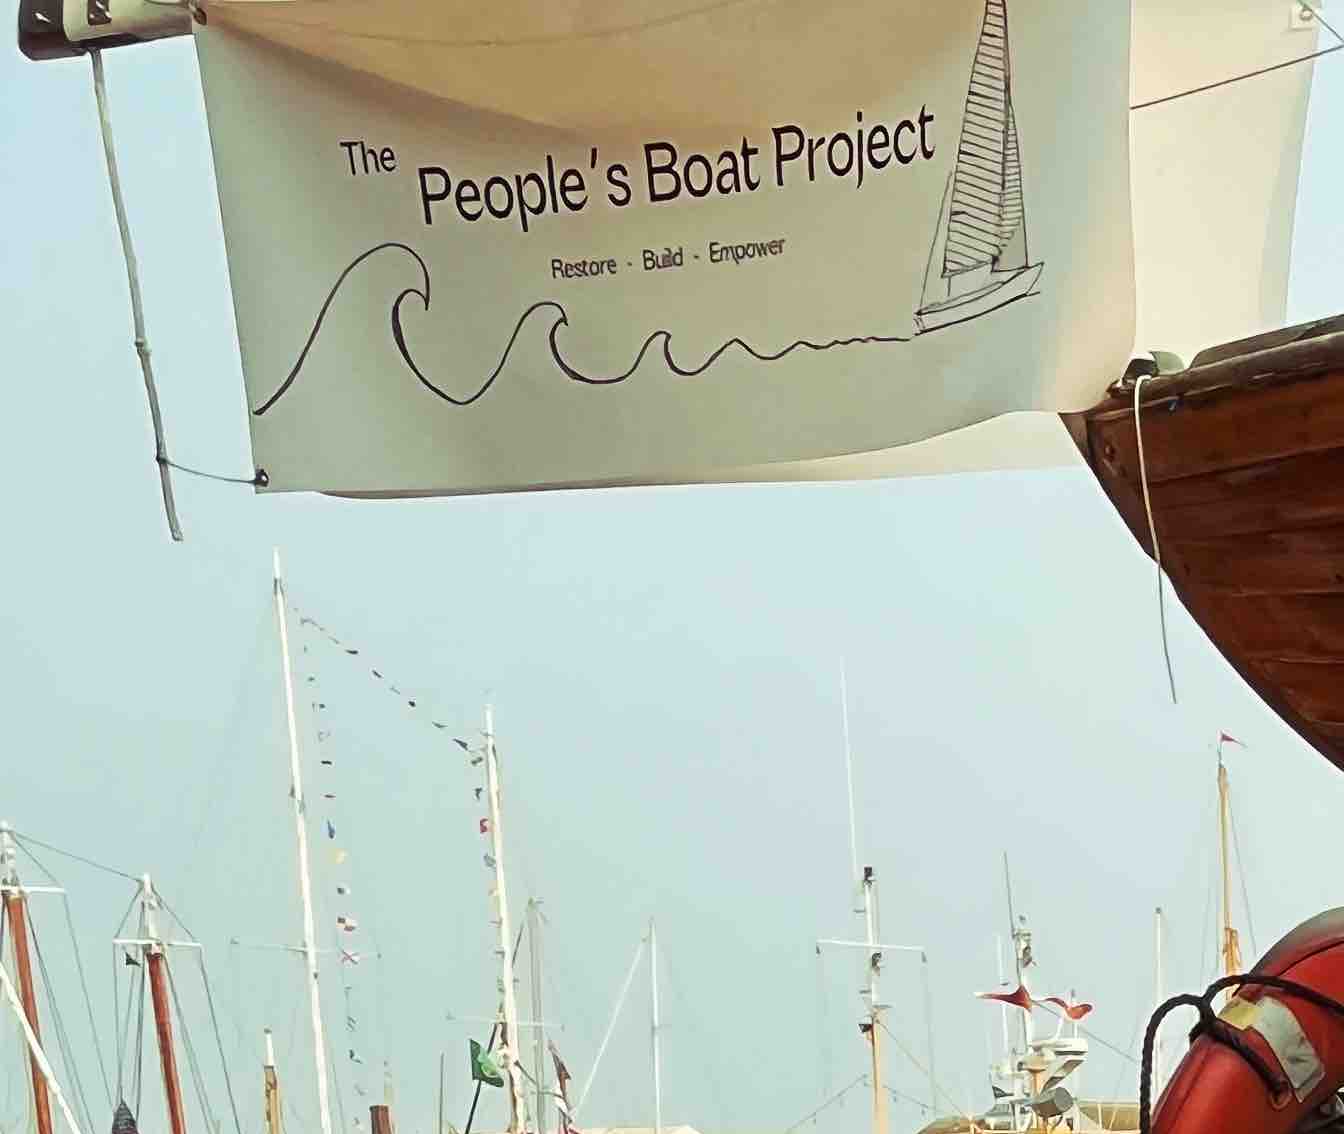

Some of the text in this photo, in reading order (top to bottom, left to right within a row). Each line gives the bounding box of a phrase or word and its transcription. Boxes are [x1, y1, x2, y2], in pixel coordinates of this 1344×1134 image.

[339, 140, 398, 175] The
[417, 103, 936, 233] People's Boat Project
[551, 256, 617, 280] Restore
[642, 245, 685, 272] Build
[708, 237, 786, 265] Empower
